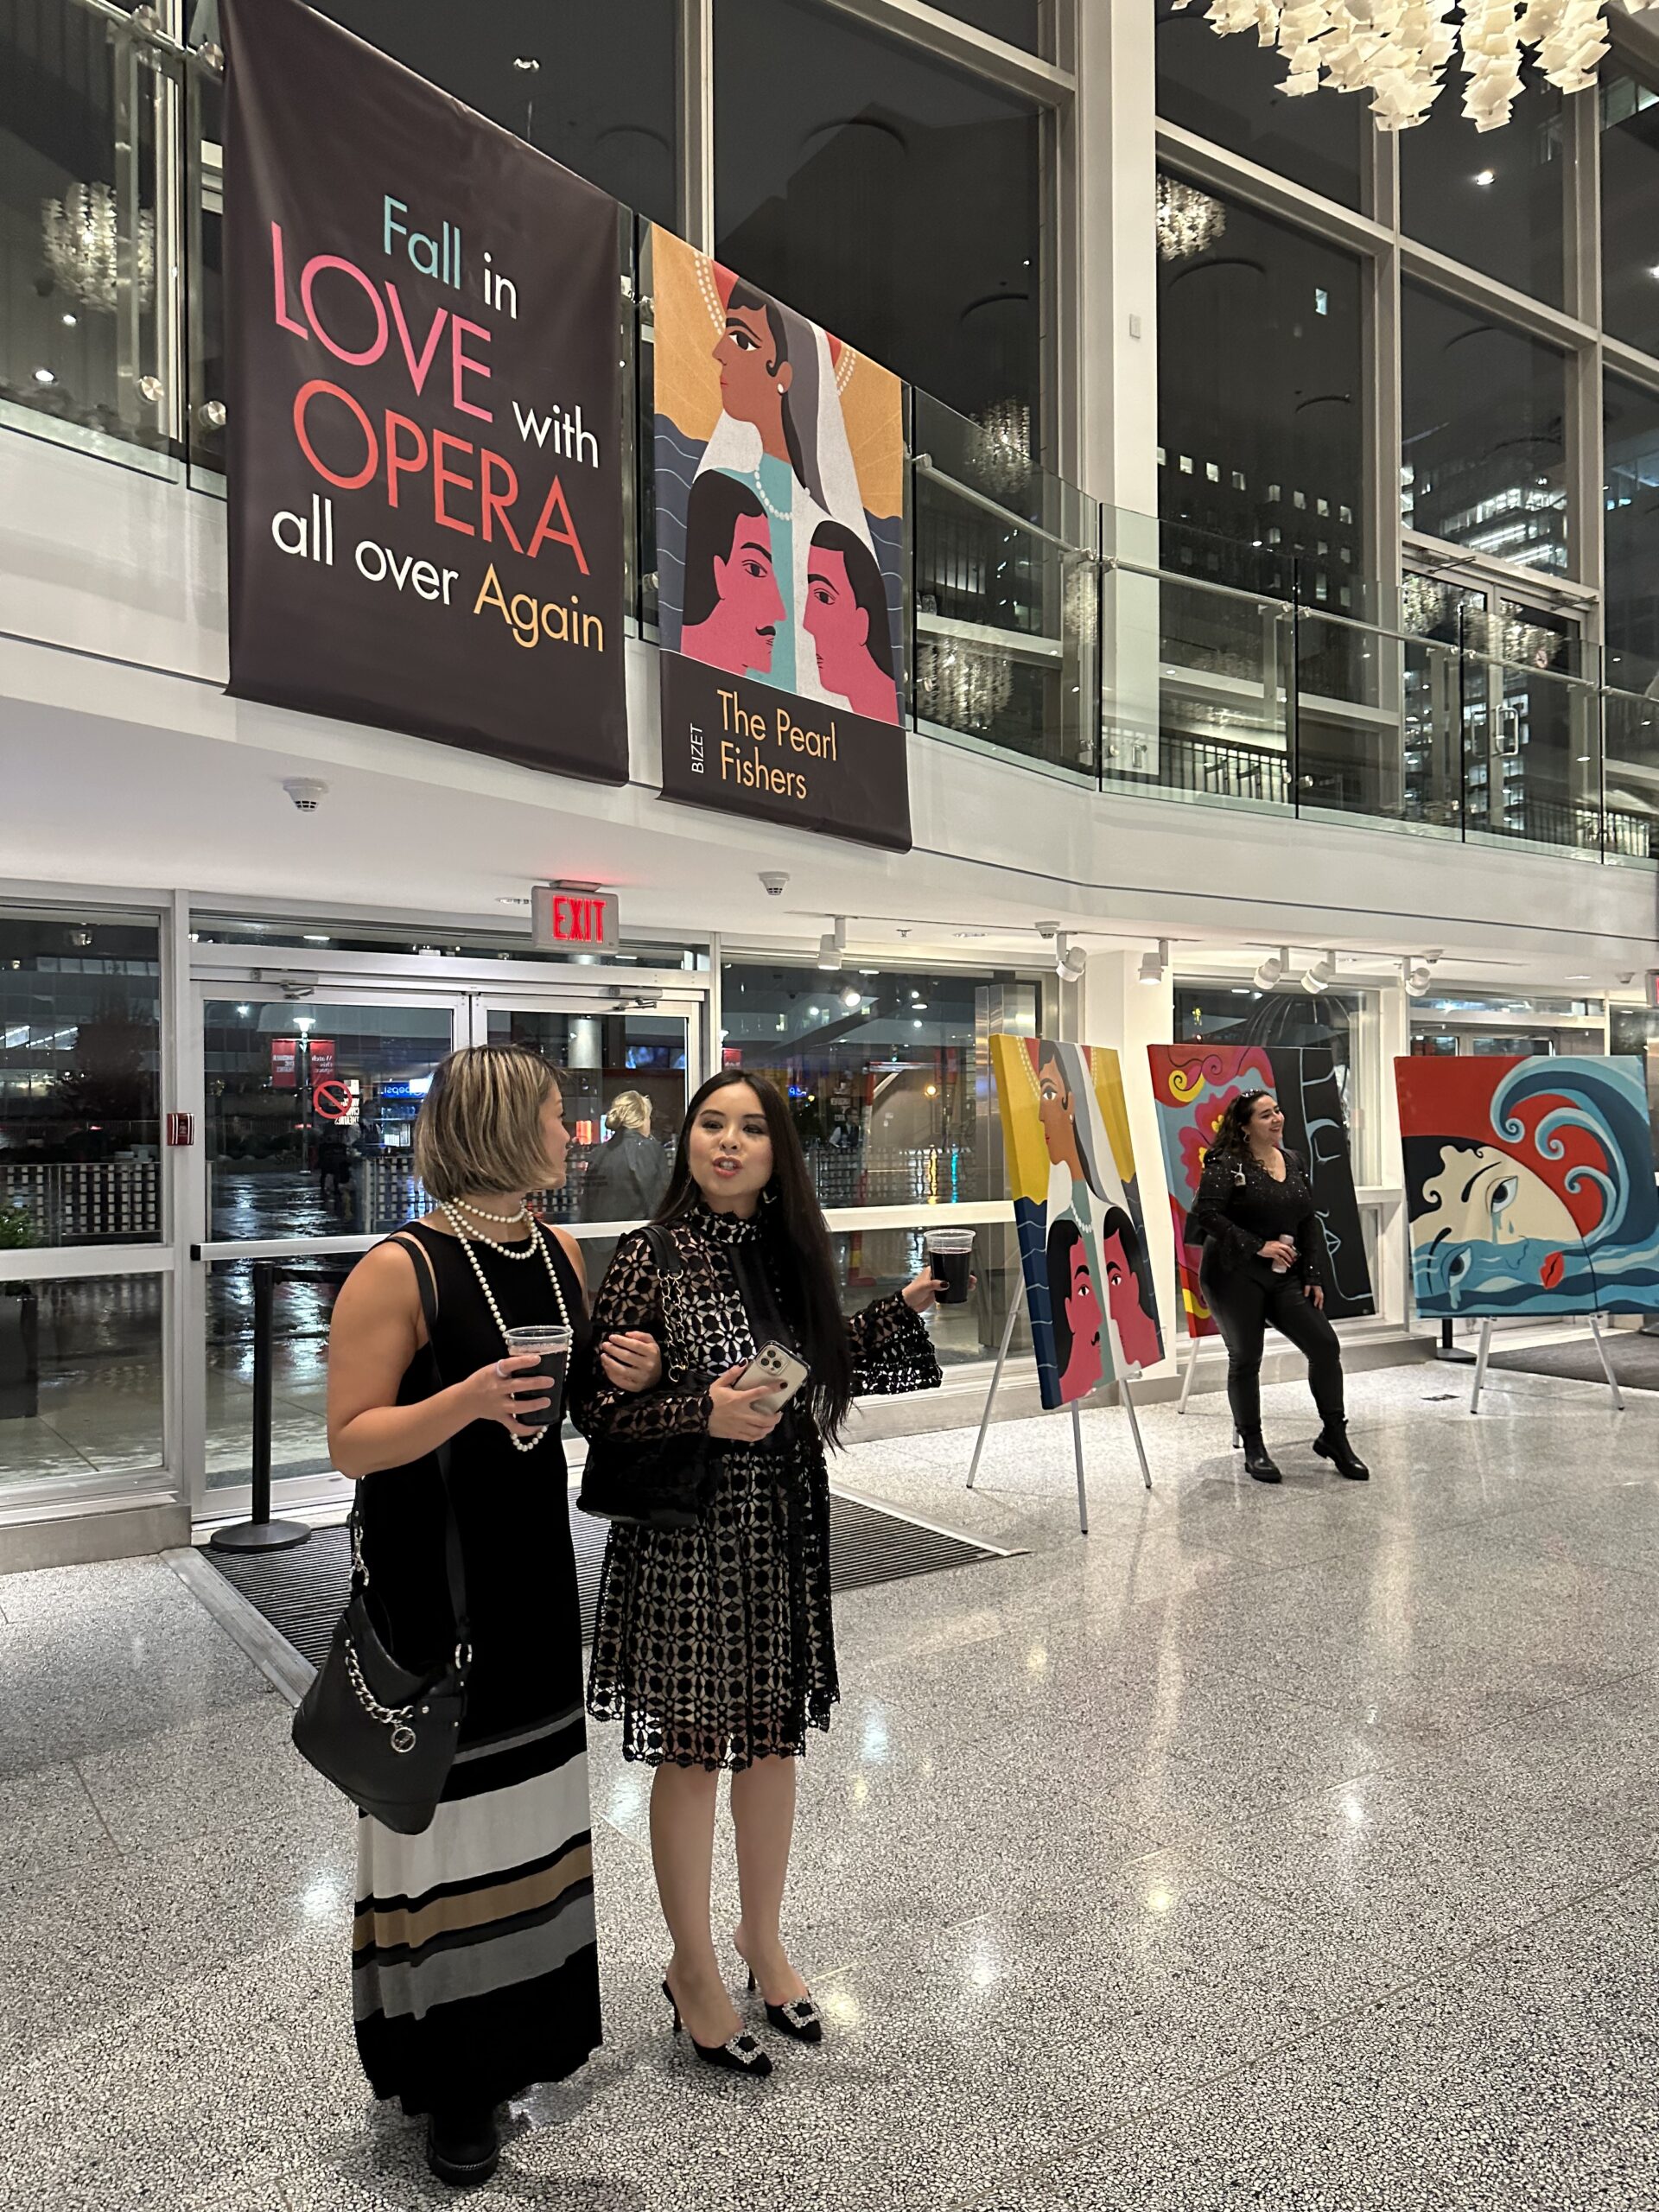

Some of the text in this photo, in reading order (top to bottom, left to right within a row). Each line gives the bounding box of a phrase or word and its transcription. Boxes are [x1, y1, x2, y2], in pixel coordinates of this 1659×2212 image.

[384, 194, 518, 320] Fall in
[270, 220, 599, 469] LOVE with
[293, 378, 591, 576] OPERA
[271, 493, 604, 652] all over Again
[690, 722, 704, 774] BIZET
[717, 689, 837, 761] The Pearl
[721, 741, 808, 799] Fishers
[552, 895, 607, 944] EXIT
